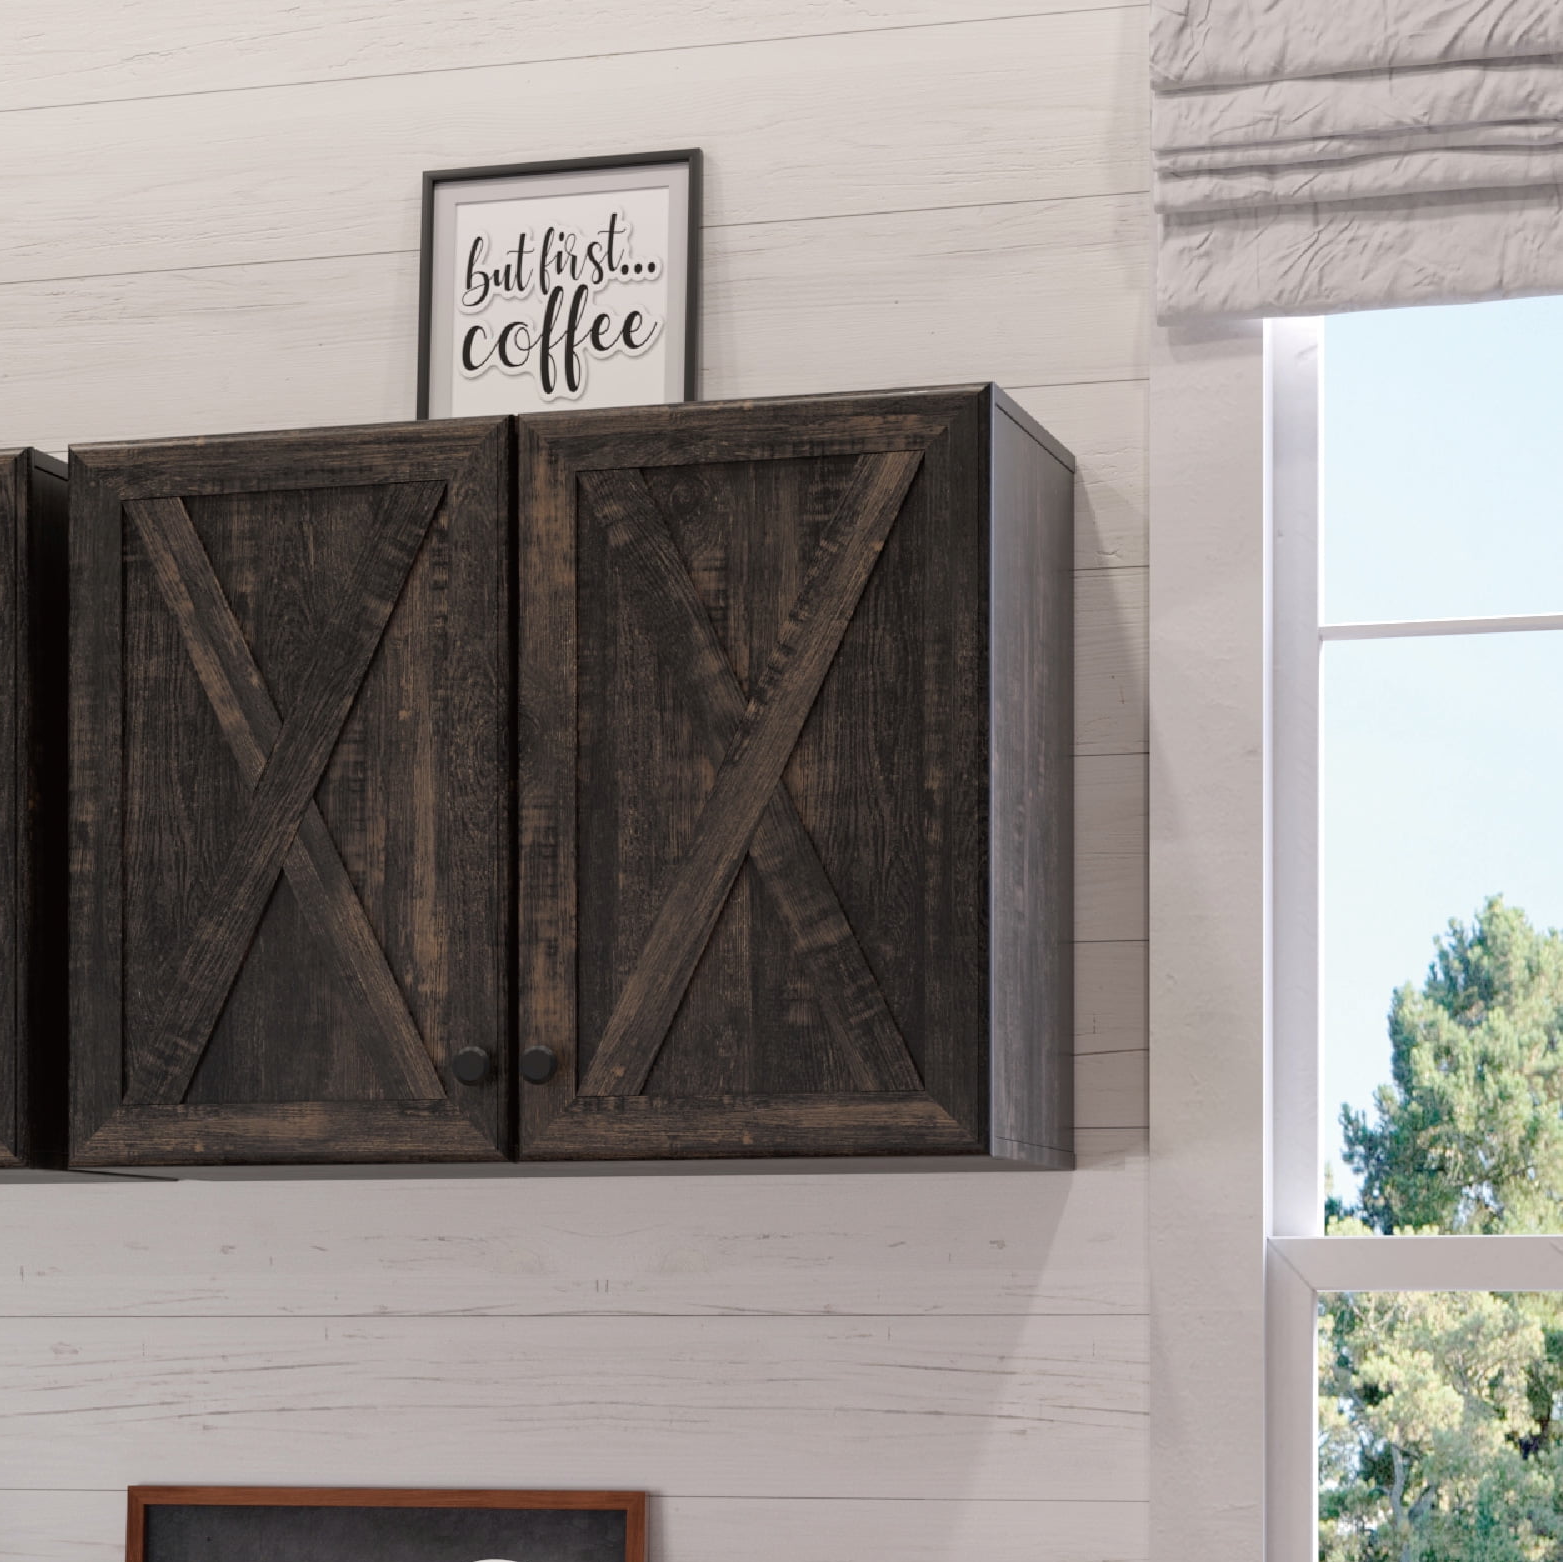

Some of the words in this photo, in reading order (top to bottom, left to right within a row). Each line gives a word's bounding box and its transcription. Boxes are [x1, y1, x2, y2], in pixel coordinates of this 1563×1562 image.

[462, 232, 534, 307] but
[539, 213, 656, 295] first...
[462, 284, 658, 394] coffee
